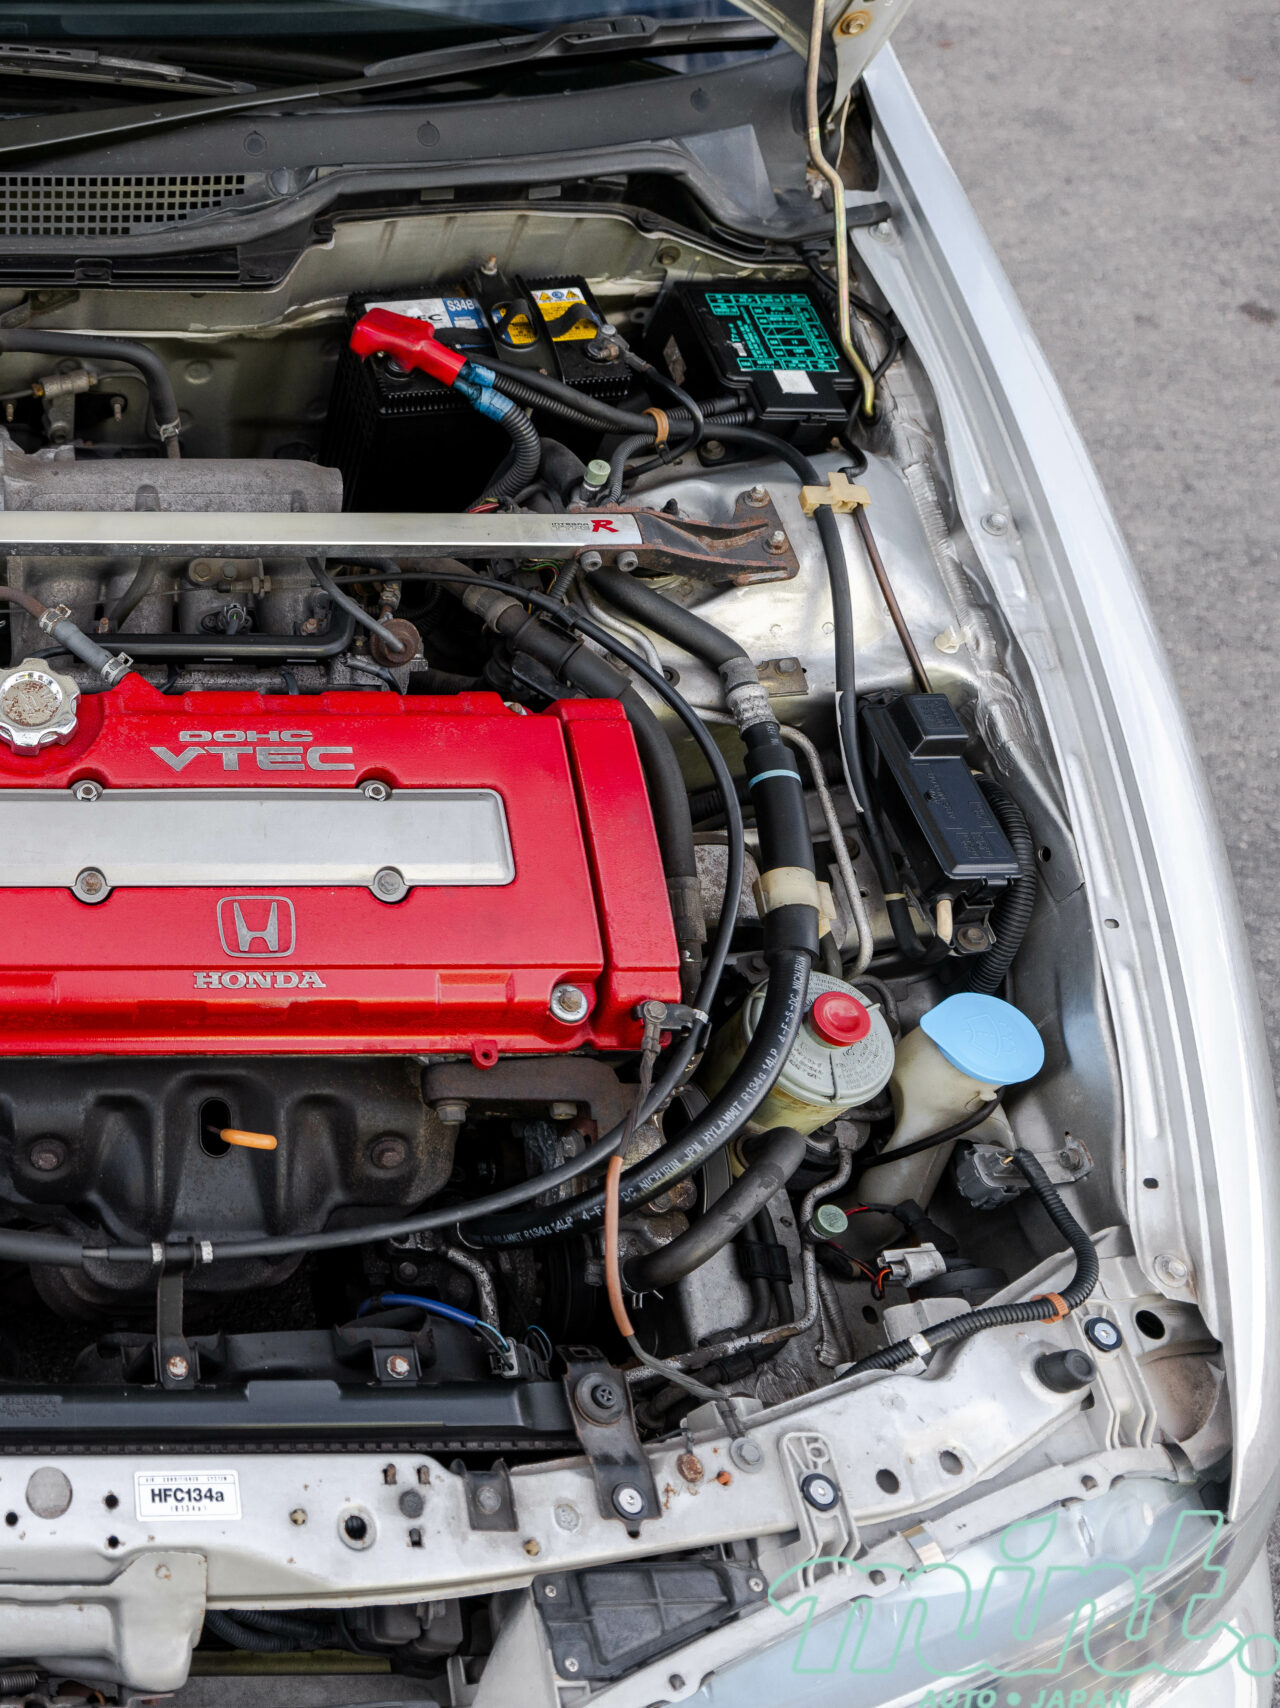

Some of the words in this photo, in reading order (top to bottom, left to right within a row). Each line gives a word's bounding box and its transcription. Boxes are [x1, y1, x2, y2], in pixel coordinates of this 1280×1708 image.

[179, 730, 313, 742] DOHC
[149, 746, 355, 772] VTEC
[193, 971, 327, 989] HONDA
[639, 1158, 681, 1193] NICHIRIN
[683, 1141, 705, 1162] JPN
[151, 1487, 225, 1503] HFC134a
